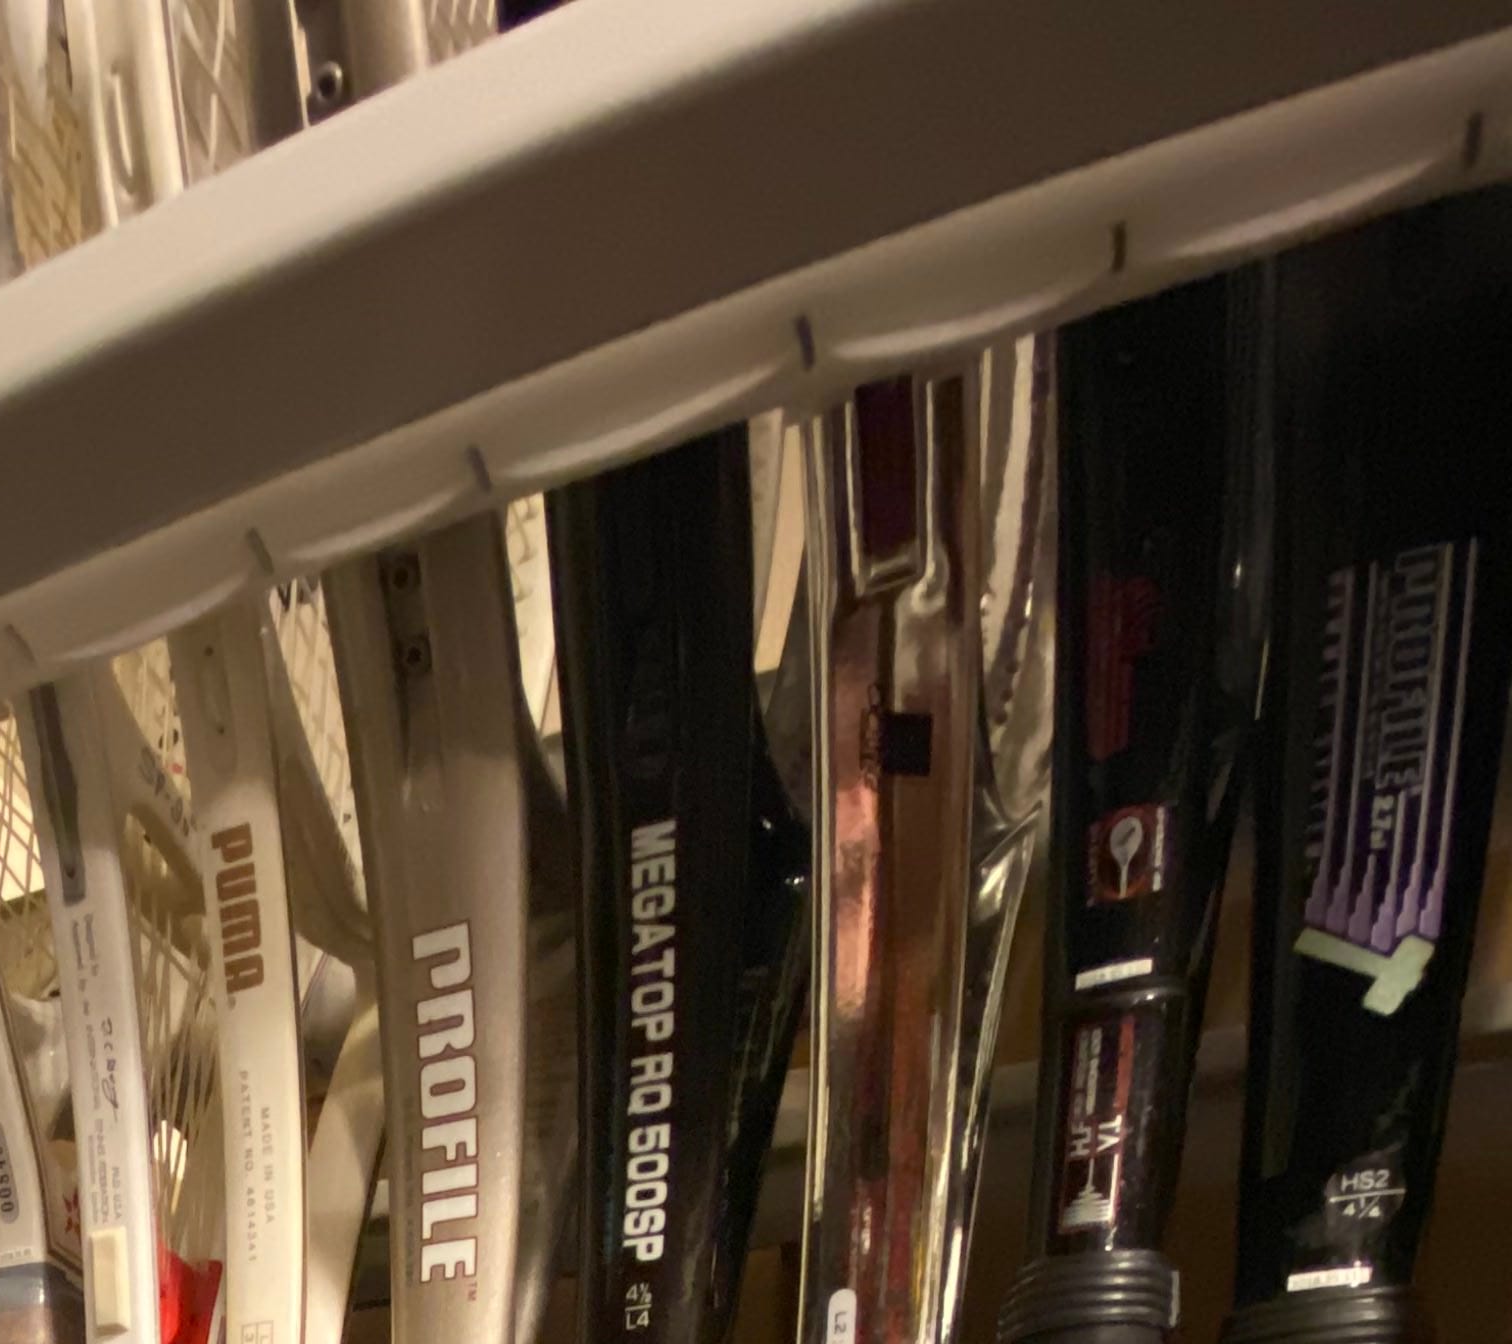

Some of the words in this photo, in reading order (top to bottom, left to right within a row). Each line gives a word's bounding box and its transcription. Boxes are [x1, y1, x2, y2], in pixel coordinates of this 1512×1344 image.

[210, 821, 265, 995] PUMA
[630, 819, 677, 1043] MEGATOP
[238, 1070, 253, 1139] PATENT
[260, 1106, 274, 1155] MADE
[410, 920, 479, 1284] PROFILE
[264, 1164, 275, 1181] IN
[621, 1122, 672, 1263] 500SP
[1340, 1168, 1391, 1193] HS2
[264, 1188, 276, 1225] USA
[624, 1309, 651, 1331] L4
